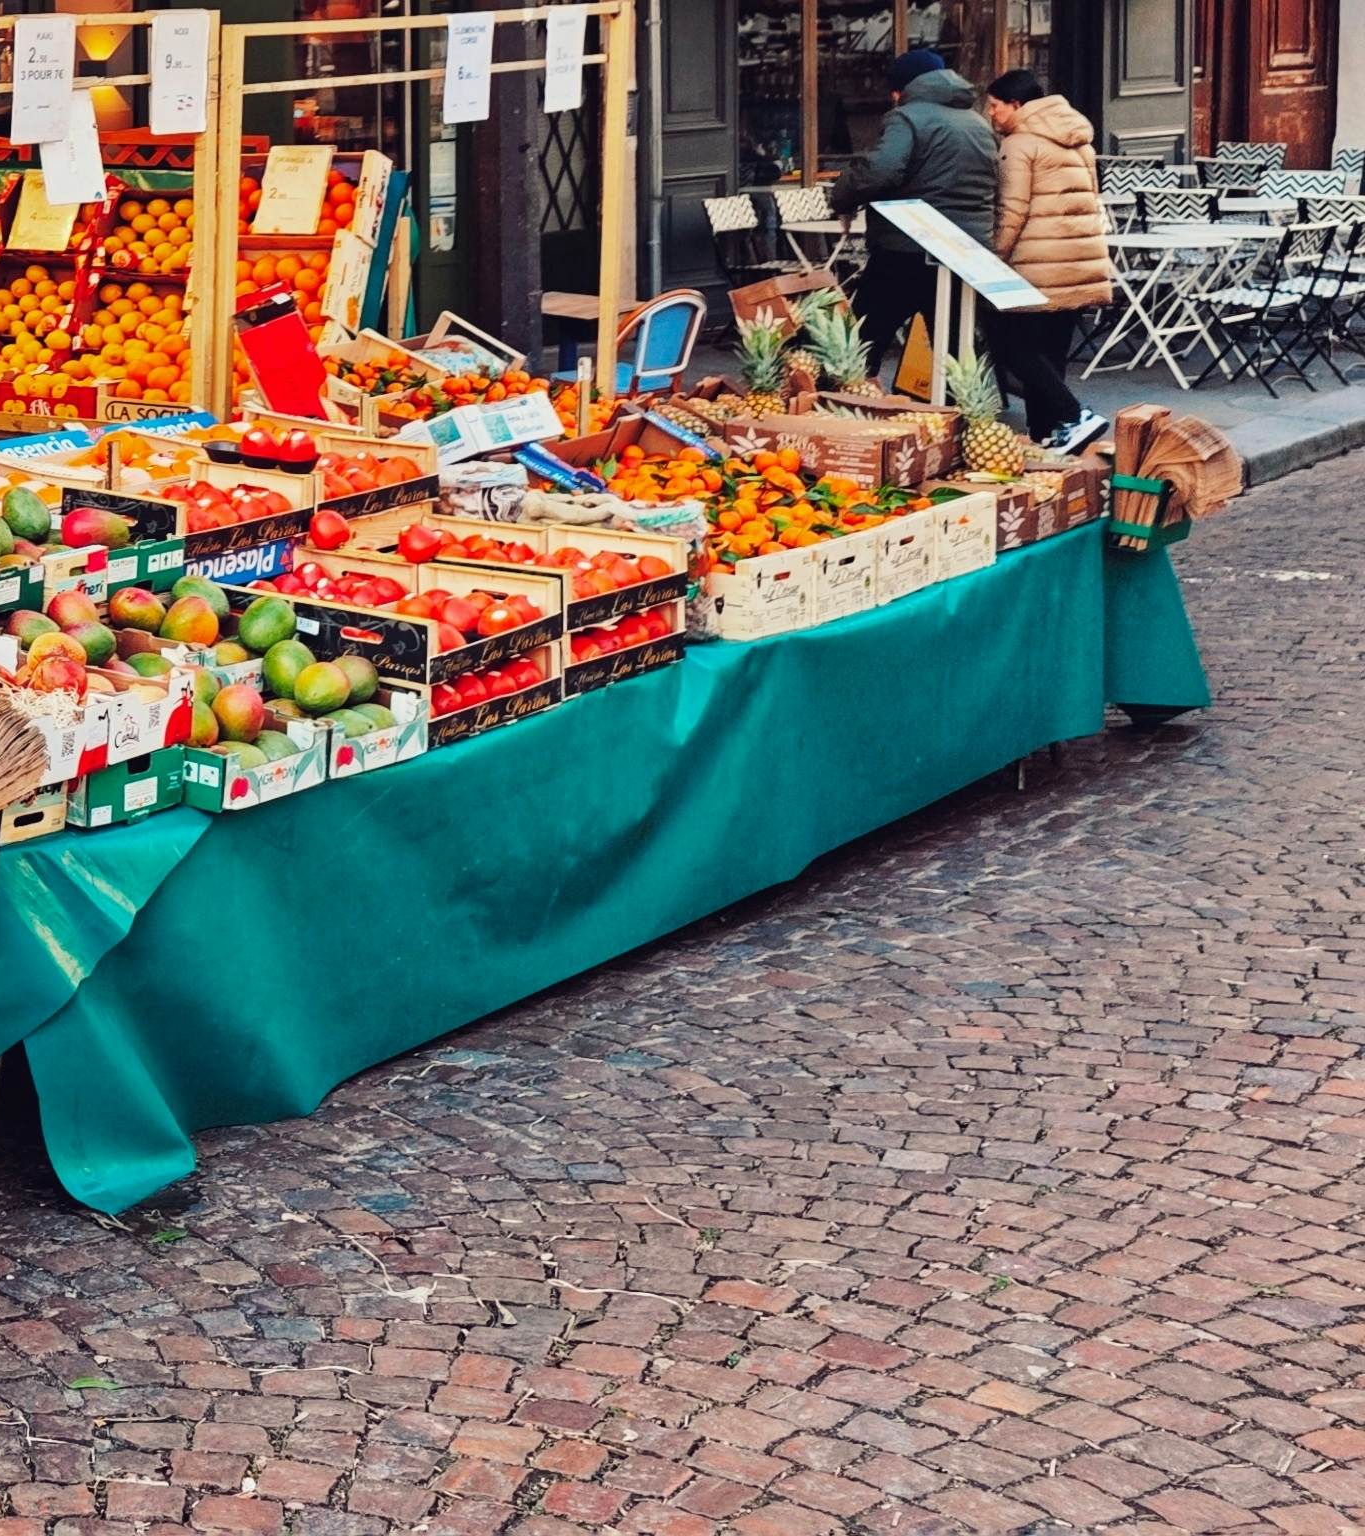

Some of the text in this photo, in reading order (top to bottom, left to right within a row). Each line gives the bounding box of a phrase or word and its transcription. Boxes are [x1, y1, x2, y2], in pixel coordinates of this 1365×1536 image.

[20, 70, 27, 81] 3
[27, 69, 54, 81] POUR
[109, 404, 133, 421] LA
[611, 654, 635, 677] Las
[469, 703, 500, 731] Las
